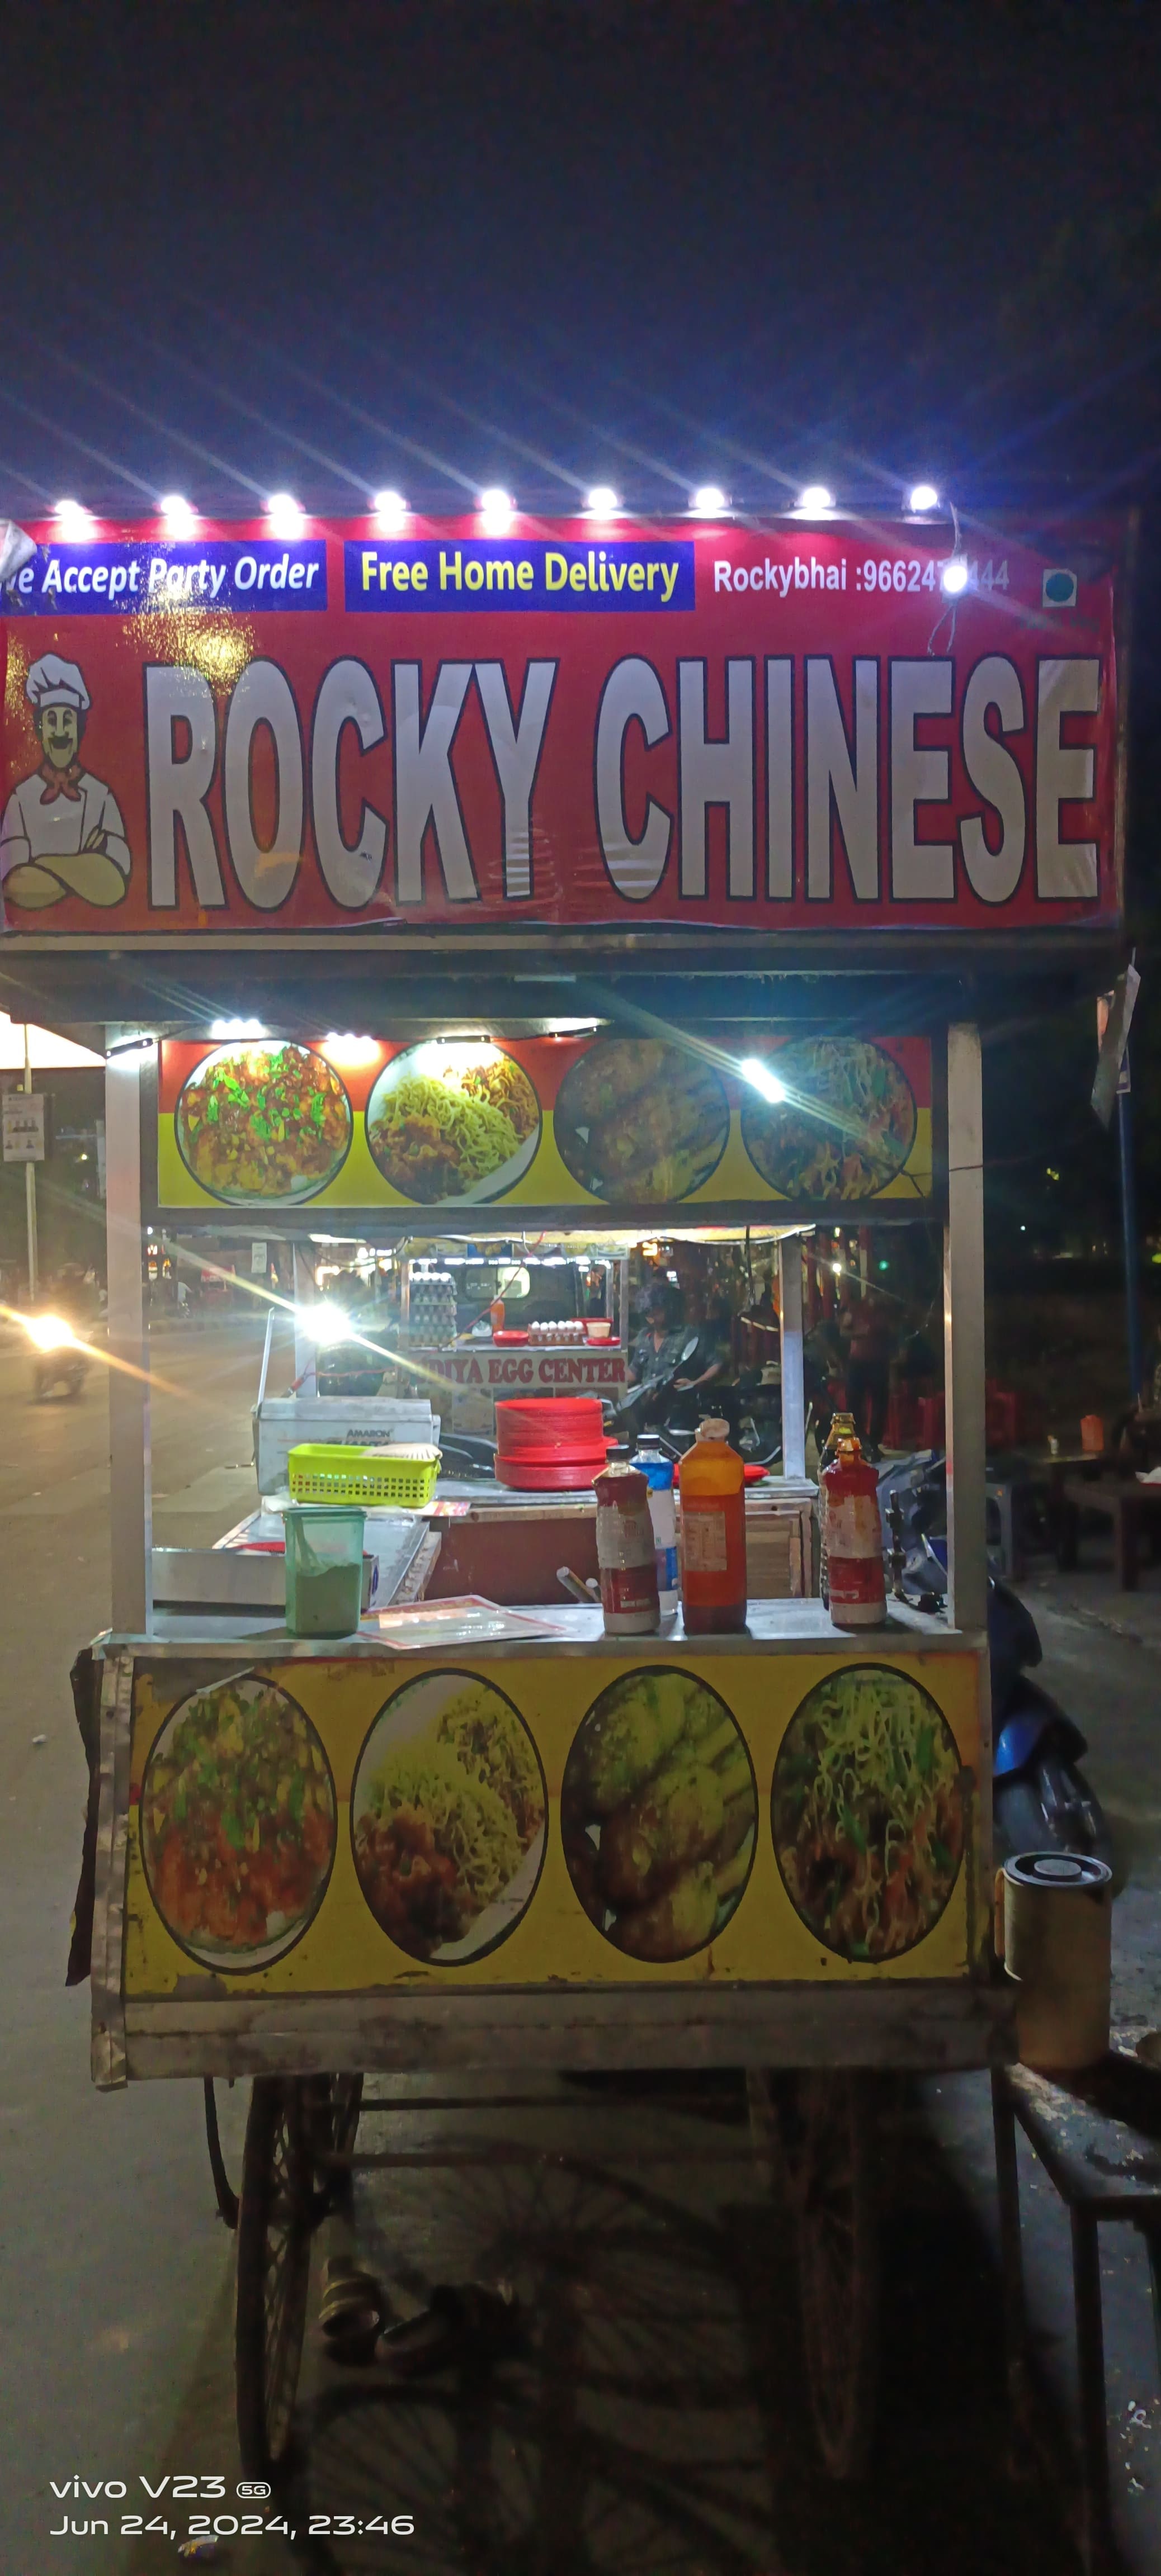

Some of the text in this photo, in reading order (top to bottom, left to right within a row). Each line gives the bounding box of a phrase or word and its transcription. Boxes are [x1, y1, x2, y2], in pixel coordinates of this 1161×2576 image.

[41, 559, 140, 600] Accept
[148, 558, 226, 598] Party
[234, 553, 319, 590] Order
[362, 551, 678, 602] Free Home Delivery
[714, 557, 846, 598] Rockybhai
[144, 654, 1100, 912] ROCKY CHINESE
[488, 1358, 534, 1384] EGG
[539, 1357, 625, 1384] CENTER
